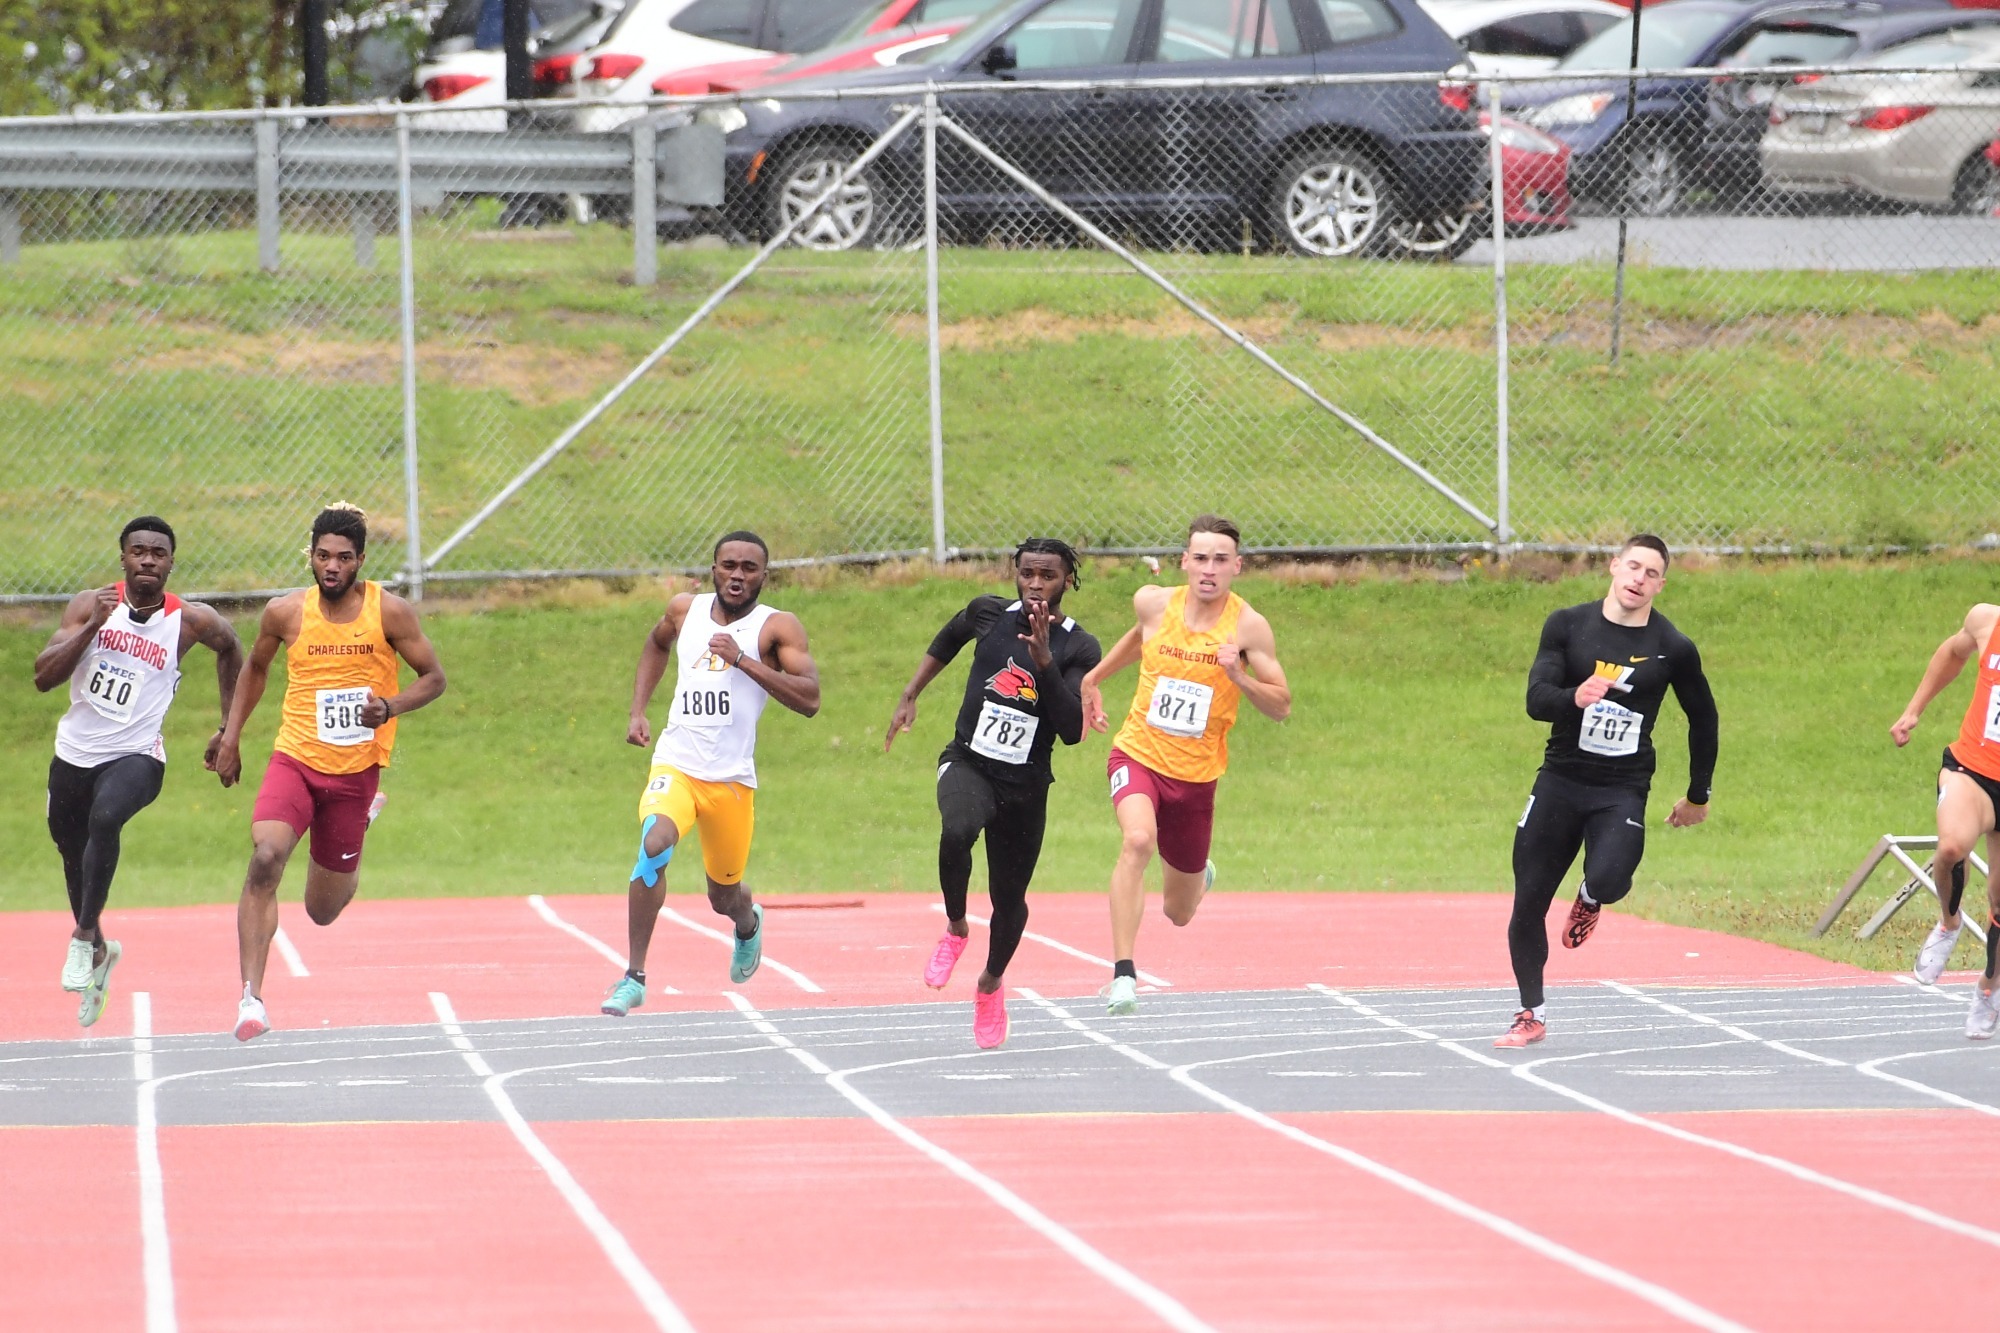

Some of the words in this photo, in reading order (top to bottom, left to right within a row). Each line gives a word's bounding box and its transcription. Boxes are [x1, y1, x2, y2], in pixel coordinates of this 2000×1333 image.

[97, 629, 168, 670] FROSTBURG
[307, 644, 374, 655] CHARLESTON
[109, 665, 136, 680] MEC
[89, 671, 132, 705] 610
[1176, 684, 1202, 697] MEC
[336, 692, 363, 702] MEC
[682, 691, 730, 715] 1806
[1158, 693, 1197, 725] 871
[1606, 705, 1633, 717] MEC
[1001, 711, 1028, 723] MEC
[983, 715, 1026, 749] 782
[1588, 715, 1632, 741] 707
[650, 776, 667, 790] 6
